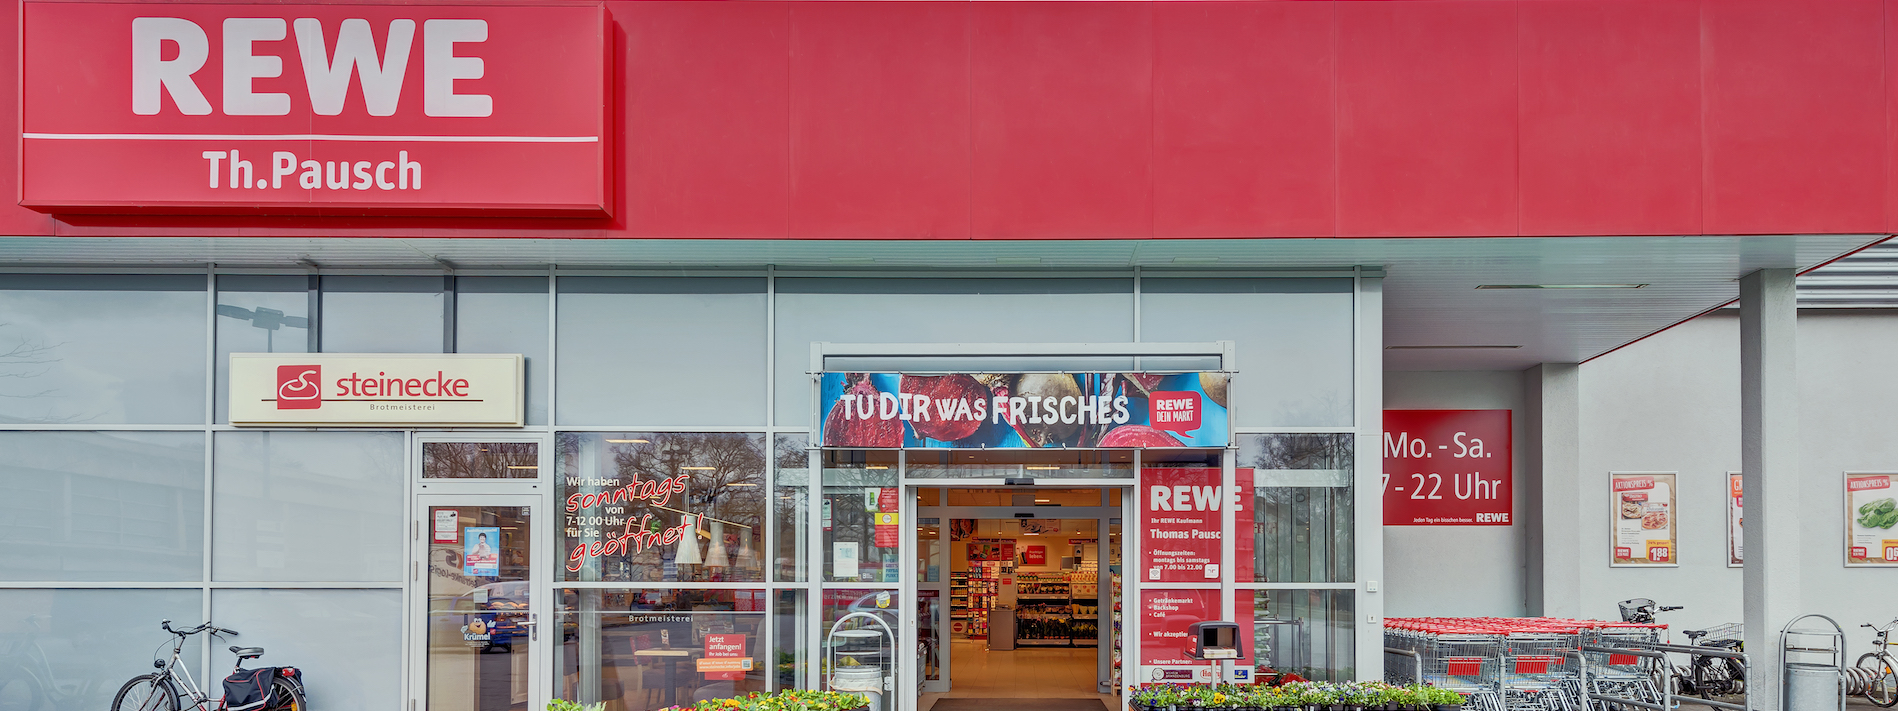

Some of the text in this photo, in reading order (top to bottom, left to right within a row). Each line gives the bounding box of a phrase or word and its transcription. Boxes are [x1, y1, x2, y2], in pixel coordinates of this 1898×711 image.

[131, 17, 494, 118] REWE
[202, 150, 422, 191] Th.Pausch
[336, 370, 469, 397] steinecke
[369, 403, 436, 411] Brotmeisterei
[840, 391, 1130, 425] TU DIR WAS FRISCHES
[1156, 398, 1194, 410] REWE
[1156, 410, 1194, 422] DEIN MARKT
[1383, 431, 1432, 458] Mo.
[1453, 431, 1492, 458] Sa.
[566, 476, 620, 486] Wir haben
[1410, 473, 1443, 500] 22
[1454, 472, 1502, 500] Uhr
[1614, 479, 1647, 490] AKTIONSPREIS
[1850, 479, 1882, 489] AKTIONSPREIS
[566, 472, 690, 512] sonntags
[605, 506, 625, 515] von
[566, 516, 625, 526] 7-12 00 Uhr
[1476, 512, 1509, 523] REWE
[566, 528, 600, 538] für Sie
[1150, 528, 1189, 539] Thomas
[628, 614, 694, 623] Brotmeisterei
[464, 632, 491, 641] Krümel
[709, 643, 742, 652] anfangen!
